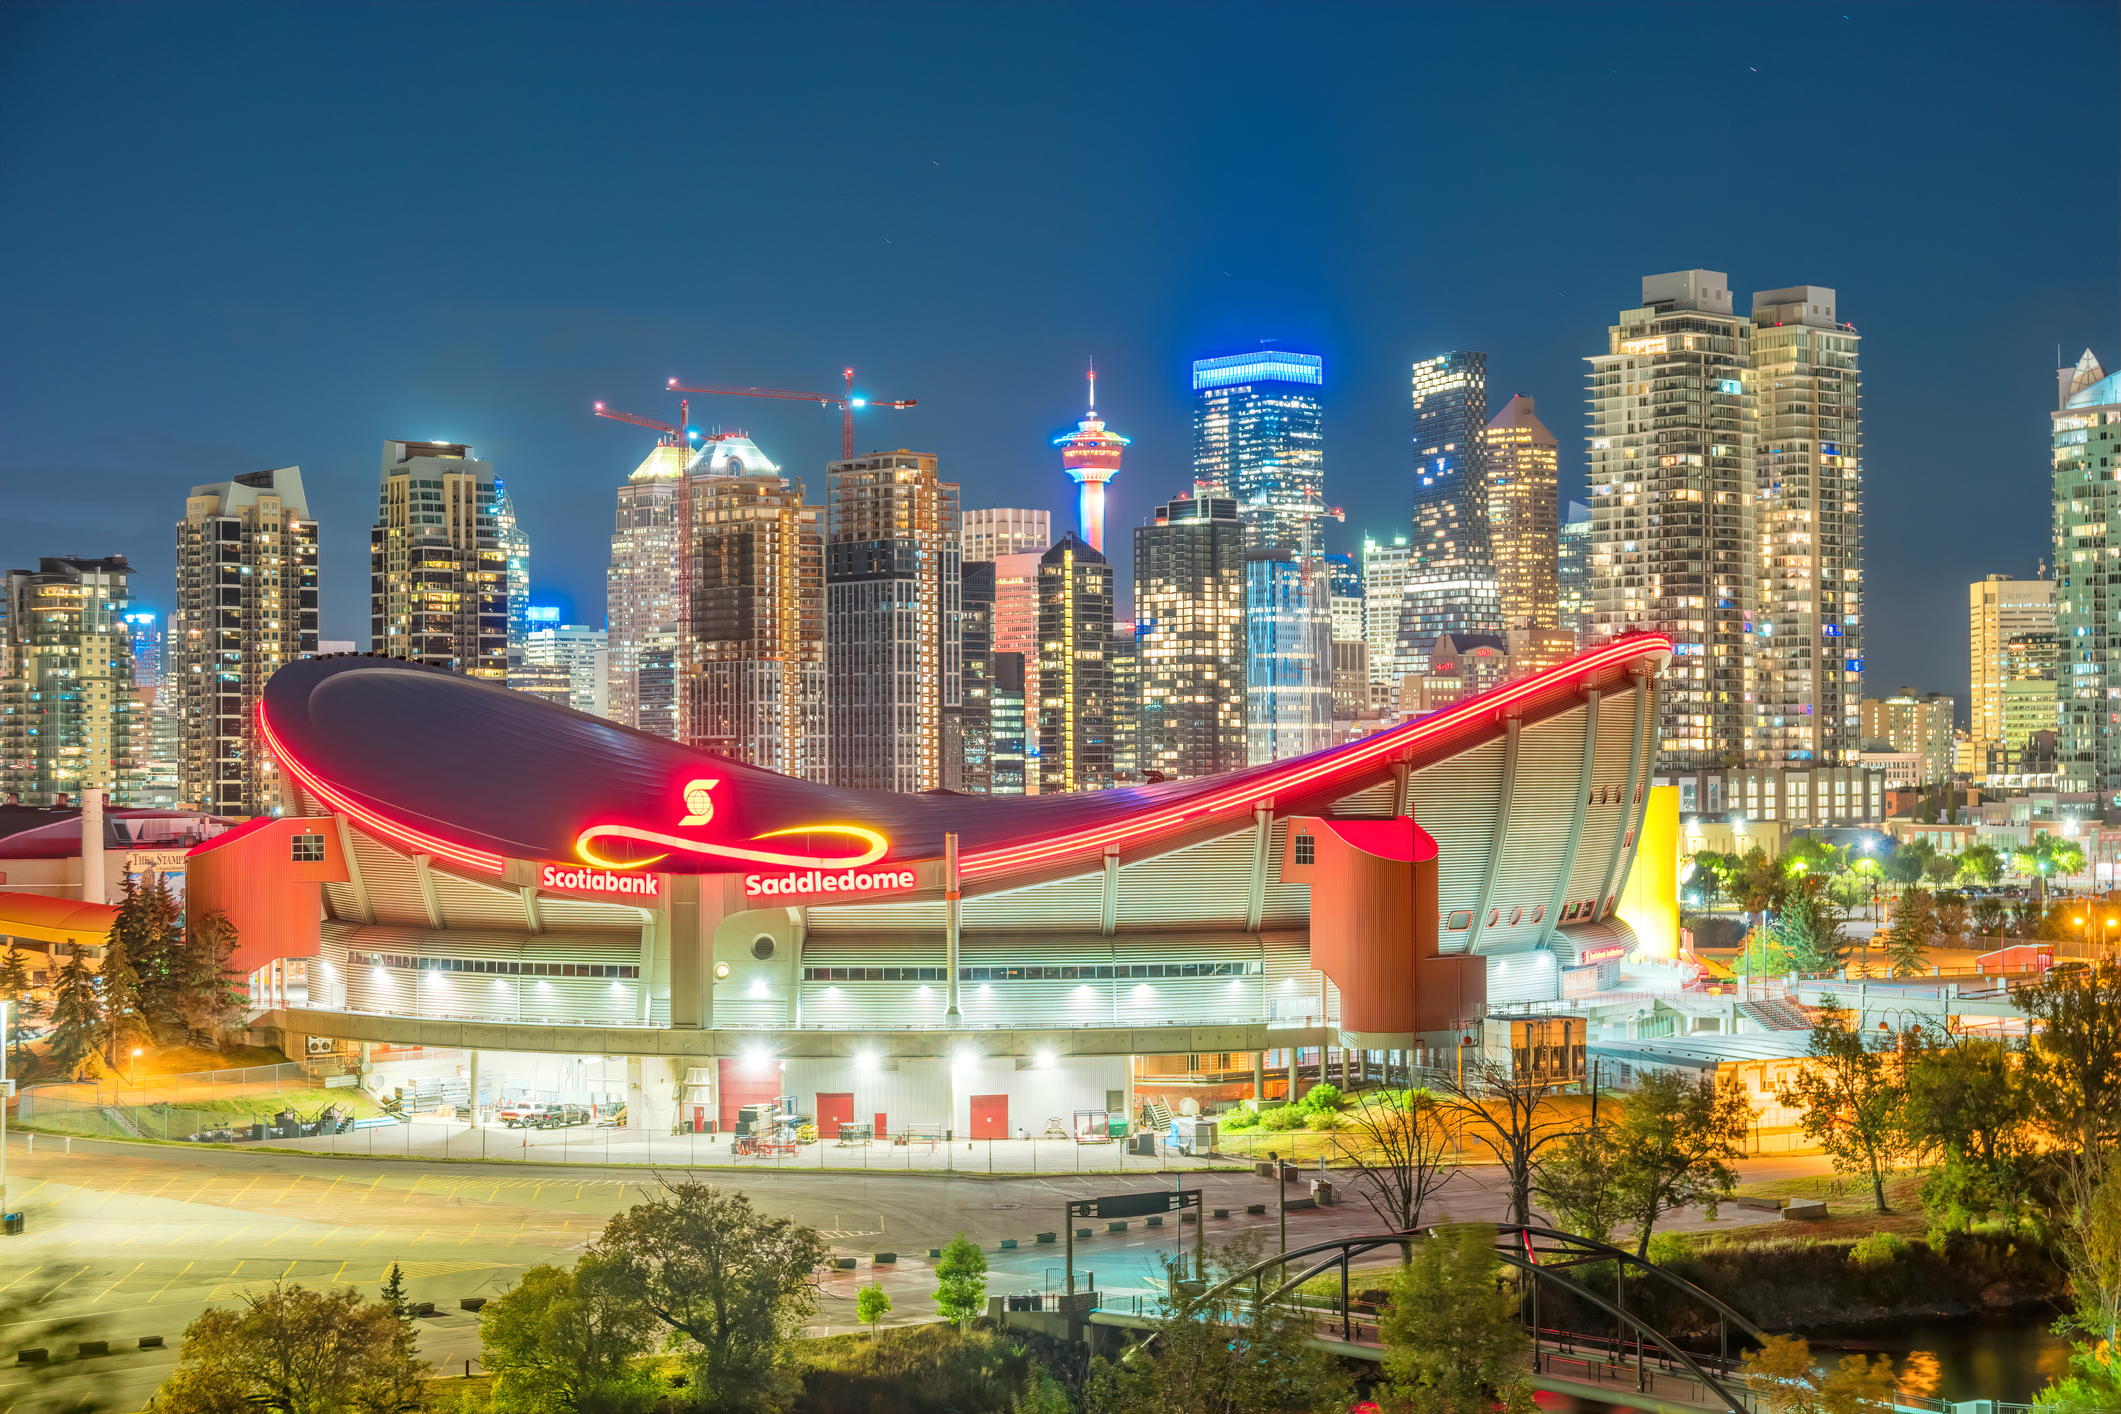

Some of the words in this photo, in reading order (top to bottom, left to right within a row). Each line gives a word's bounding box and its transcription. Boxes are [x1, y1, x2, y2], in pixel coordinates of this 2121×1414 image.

[133, 853, 148, 865] THE
[543, 866, 658, 895] Scotiabank
[746, 871, 914, 896] Saddledome
